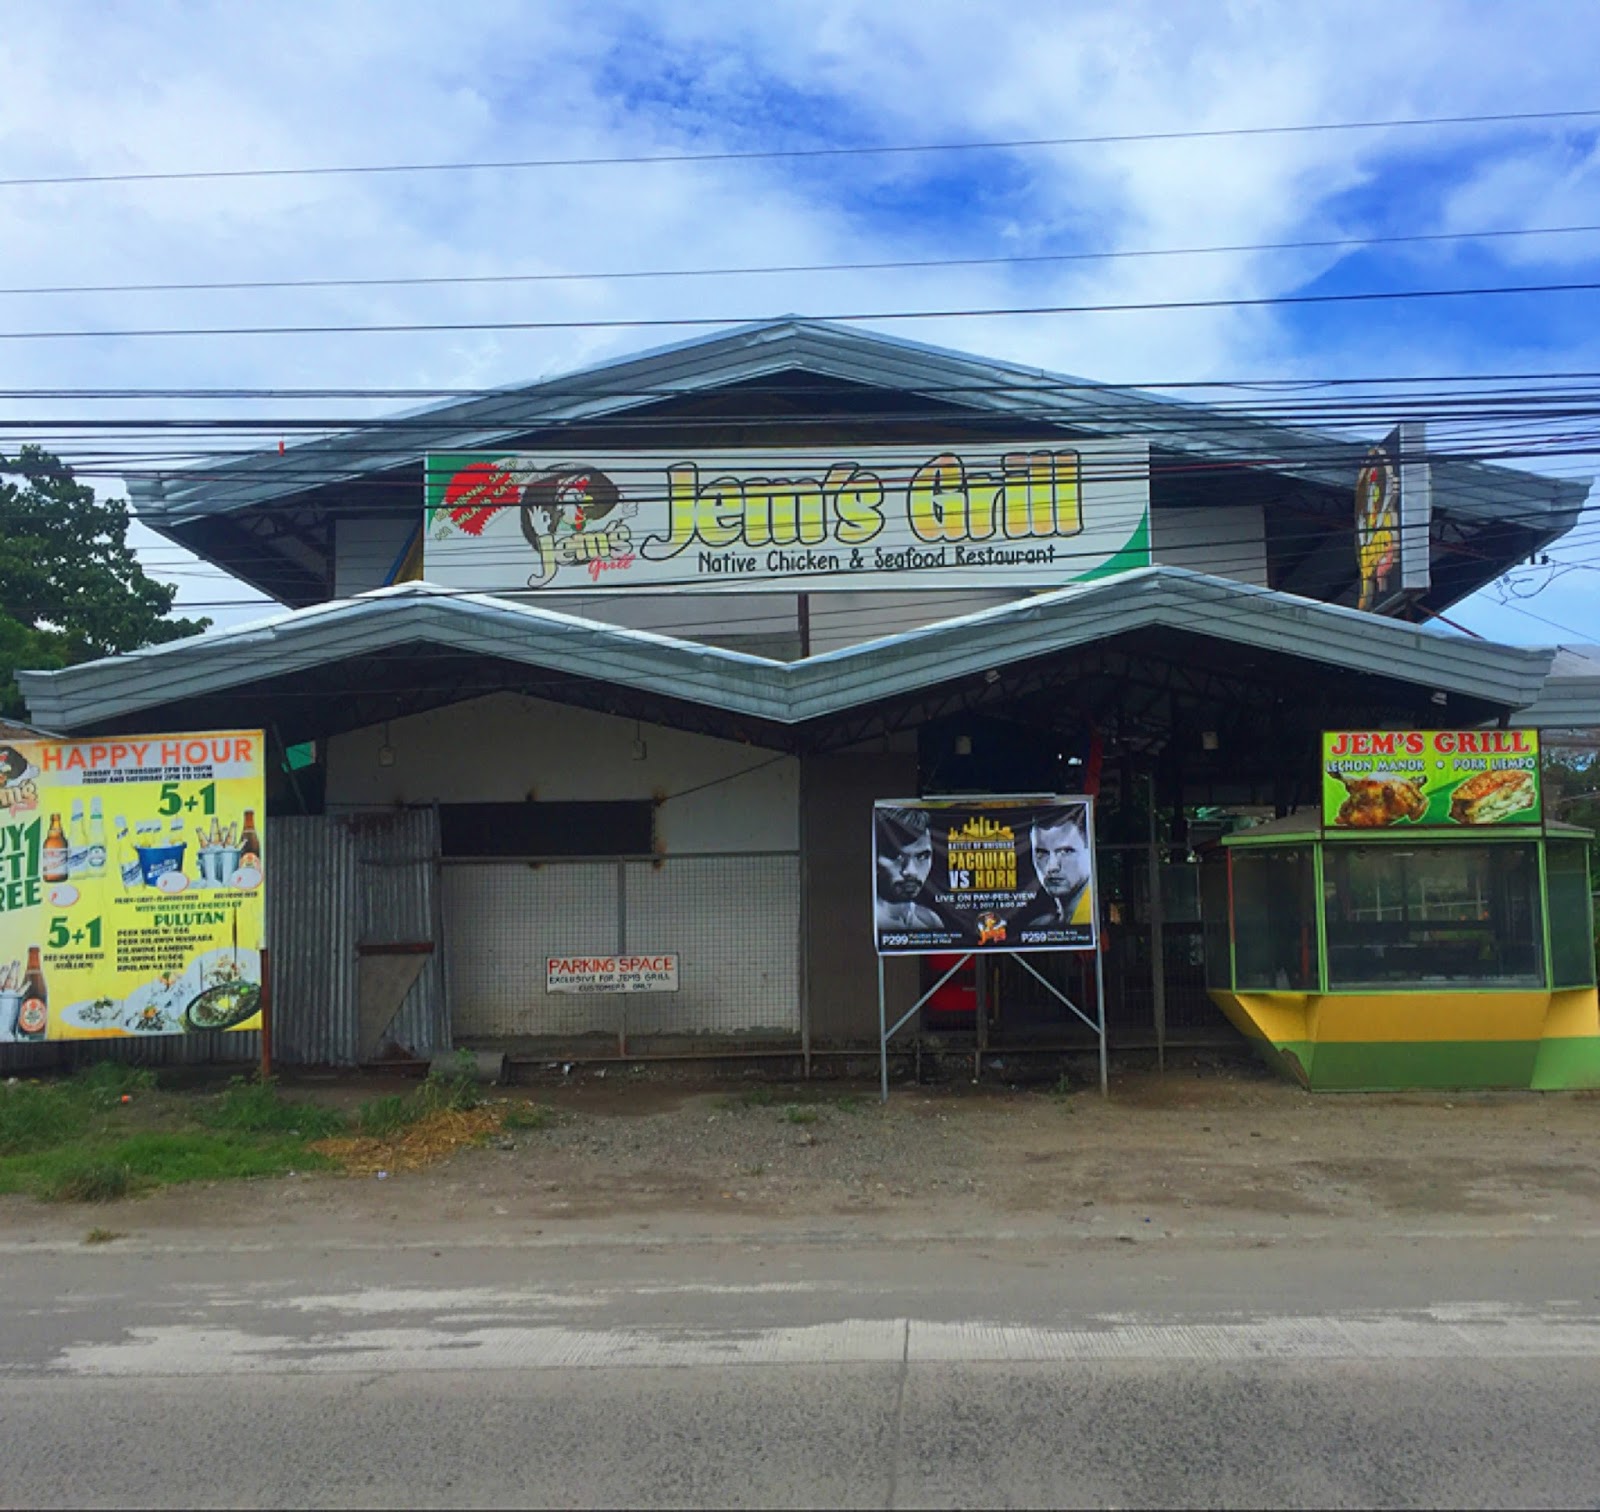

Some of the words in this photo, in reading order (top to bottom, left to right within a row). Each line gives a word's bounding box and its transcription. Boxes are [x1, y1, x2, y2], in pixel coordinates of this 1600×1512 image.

[640, 462, 885, 561] Jem's
[906, 450, 1085, 543] Grill
[527, 519, 633, 588] Jem's
[698, 551, 757, 573] Native
[766, 549, 840, 571] Chicken
[849, 548, 864, 569] &
[874, 546, 946, 569] Seafood
[954, 544, 1056, 567] Restaurant
[1331, 732, 1425, 755] JEM'S
[1434, 731, 1530, 754] GRILL
[41, 742, 150, 772] HAPPY
[160, 738, 253, 767] HOUR
[1326, 759, 1372, 772] LECHON
[1376, 759, 1425, 771] MANOK
[1453, 758, 1487, 771] PORK
[1491, 757, 1535, 770] LIEMPO
[124, 767, 162, 775] THURSDAY
[157, 782, 215, 816] 5+1
[948, 852, 1016, 870] PACQUIAO
[949, 870, 970, 889] VS
[975, 870, 1017, 888] HORN
[935, 895, 955, 903] LIVE
[973, 892, 1037, 901] PAY-PER-VIEW
[154, 911, 225, 927] PULUTAN
[47, 915, 102, 949] 5+1
[549, 958, 615, 974] PARKING
[619, 957, 674, 972] SPACE
[549, 975, 596, 984] EXCLUSIVE
[600, 974, 614, 982] FOR
[644, 973, 670, 981] GRILL
